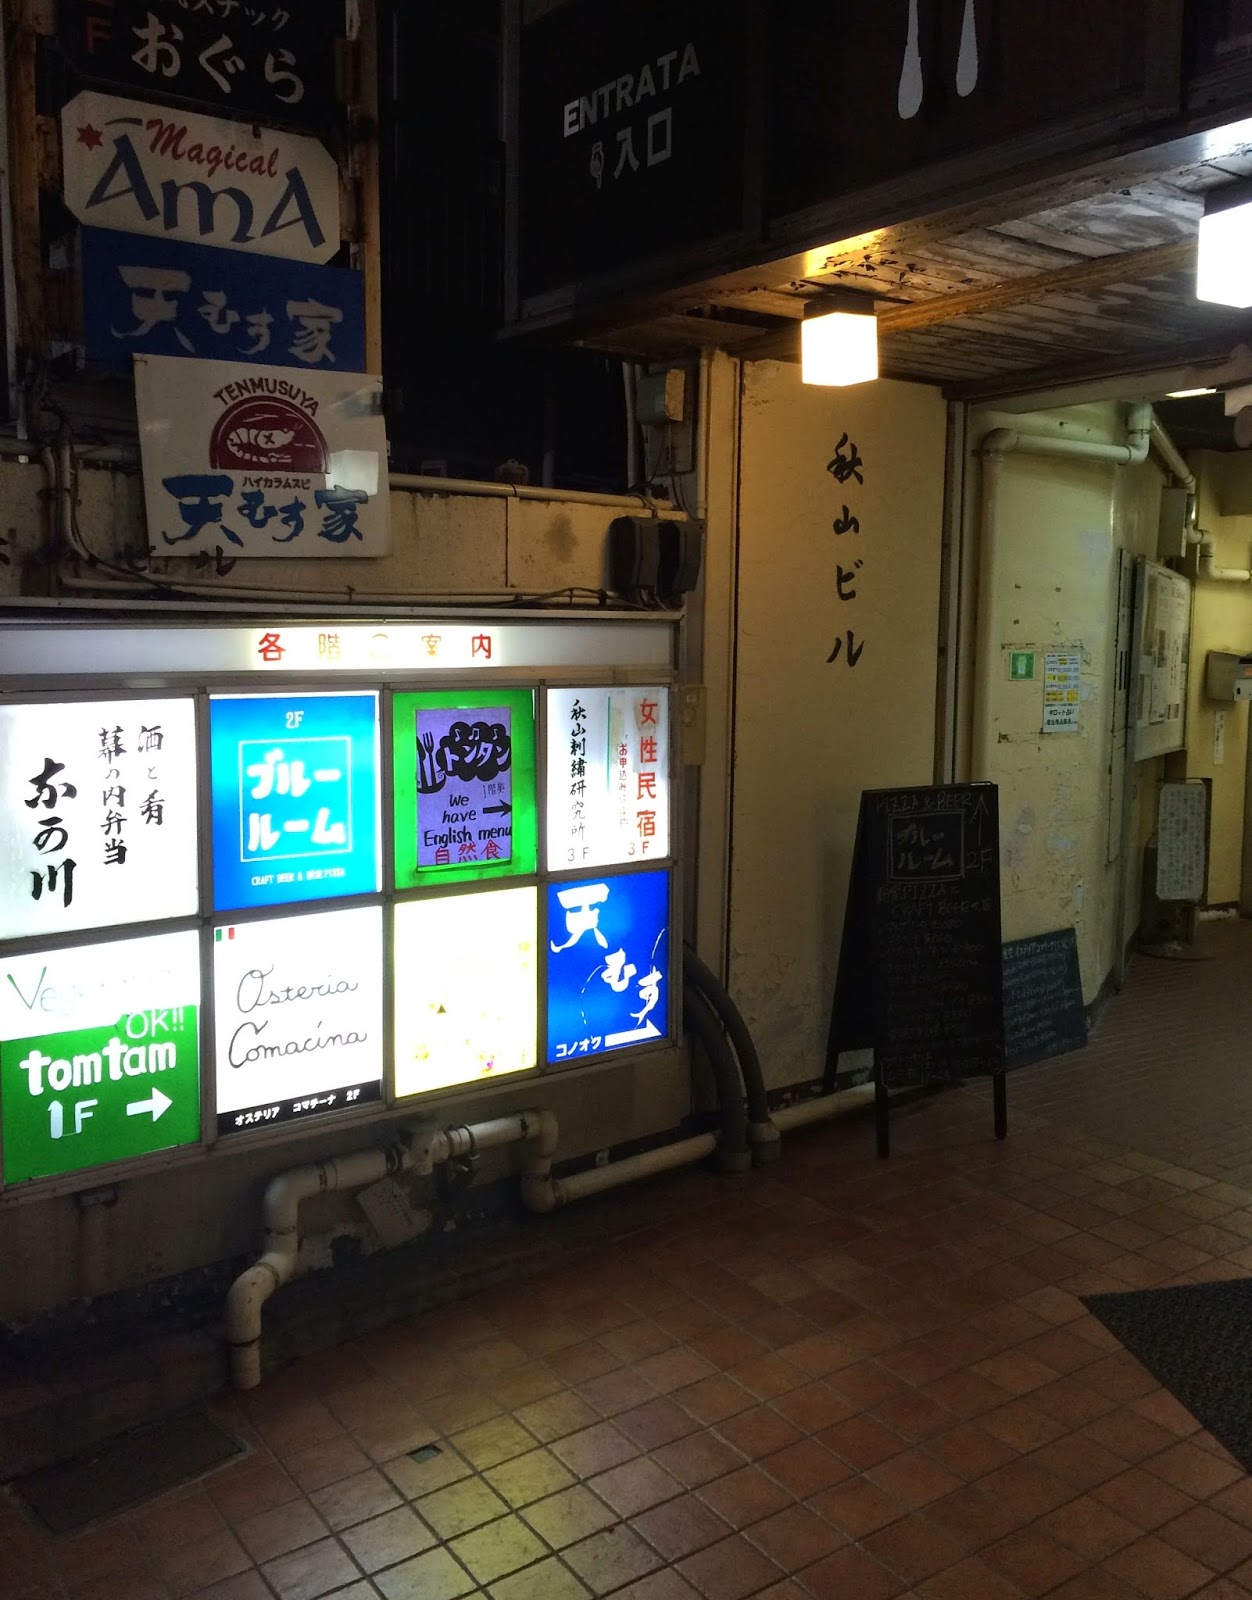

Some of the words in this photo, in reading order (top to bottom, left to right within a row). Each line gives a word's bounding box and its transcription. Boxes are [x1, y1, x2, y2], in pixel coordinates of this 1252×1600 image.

[131, 11, 305, 104] おぐら
[564, 42, 701, 138] ENTRATA
[145, 118, 279, 177] Magical
[613, 106, 673, 180] 入口
[110, 265, 344, 364] 天むす家
[213, 376, 320, 418] TENMUSUYA
[242, 476, 311, 490] ハイカラムスビ
[162, 474, 369, 548] 天むす家
[826, 432, 865, 668] 秋山ビル
[285, 711, 304, 728] 2F
[137, 725, 166, 827] 酒と肴
[246, 748, 341, 800] ブルー
[443, 741, 510, 772] トンタン
[636, 697, 658, 838] 女性民宿
[97, 725, 129, 867] 幕の内弁当
[441, 810, 477, 824] have
[876, 795, 919, 813] PIZZA
[936, 791, 973, 810] BEER
[247, 808, 347, 852] ルーム
[423, 826, 473, 848] English
[478, 827, 512, 842] menu
[896, 823, 945, 847] ブルー
[435, 839, 504, 866] 自然食
[897, 848, 954, 870] ルーム
[966, 848, 993, 873] 2F
[236, 963, 359, 1013] Osteria
[125, 1007, 184, 1039] OK!!
[19, 1037, 176, 1096] tomtam
[47, 1098, 98, 1139] 1F
[234, 1106, 281, 1126] オステリア
[293, 1094, 337, 1113] コマチーナ
[346, 1088, 361, 1102] 2F
